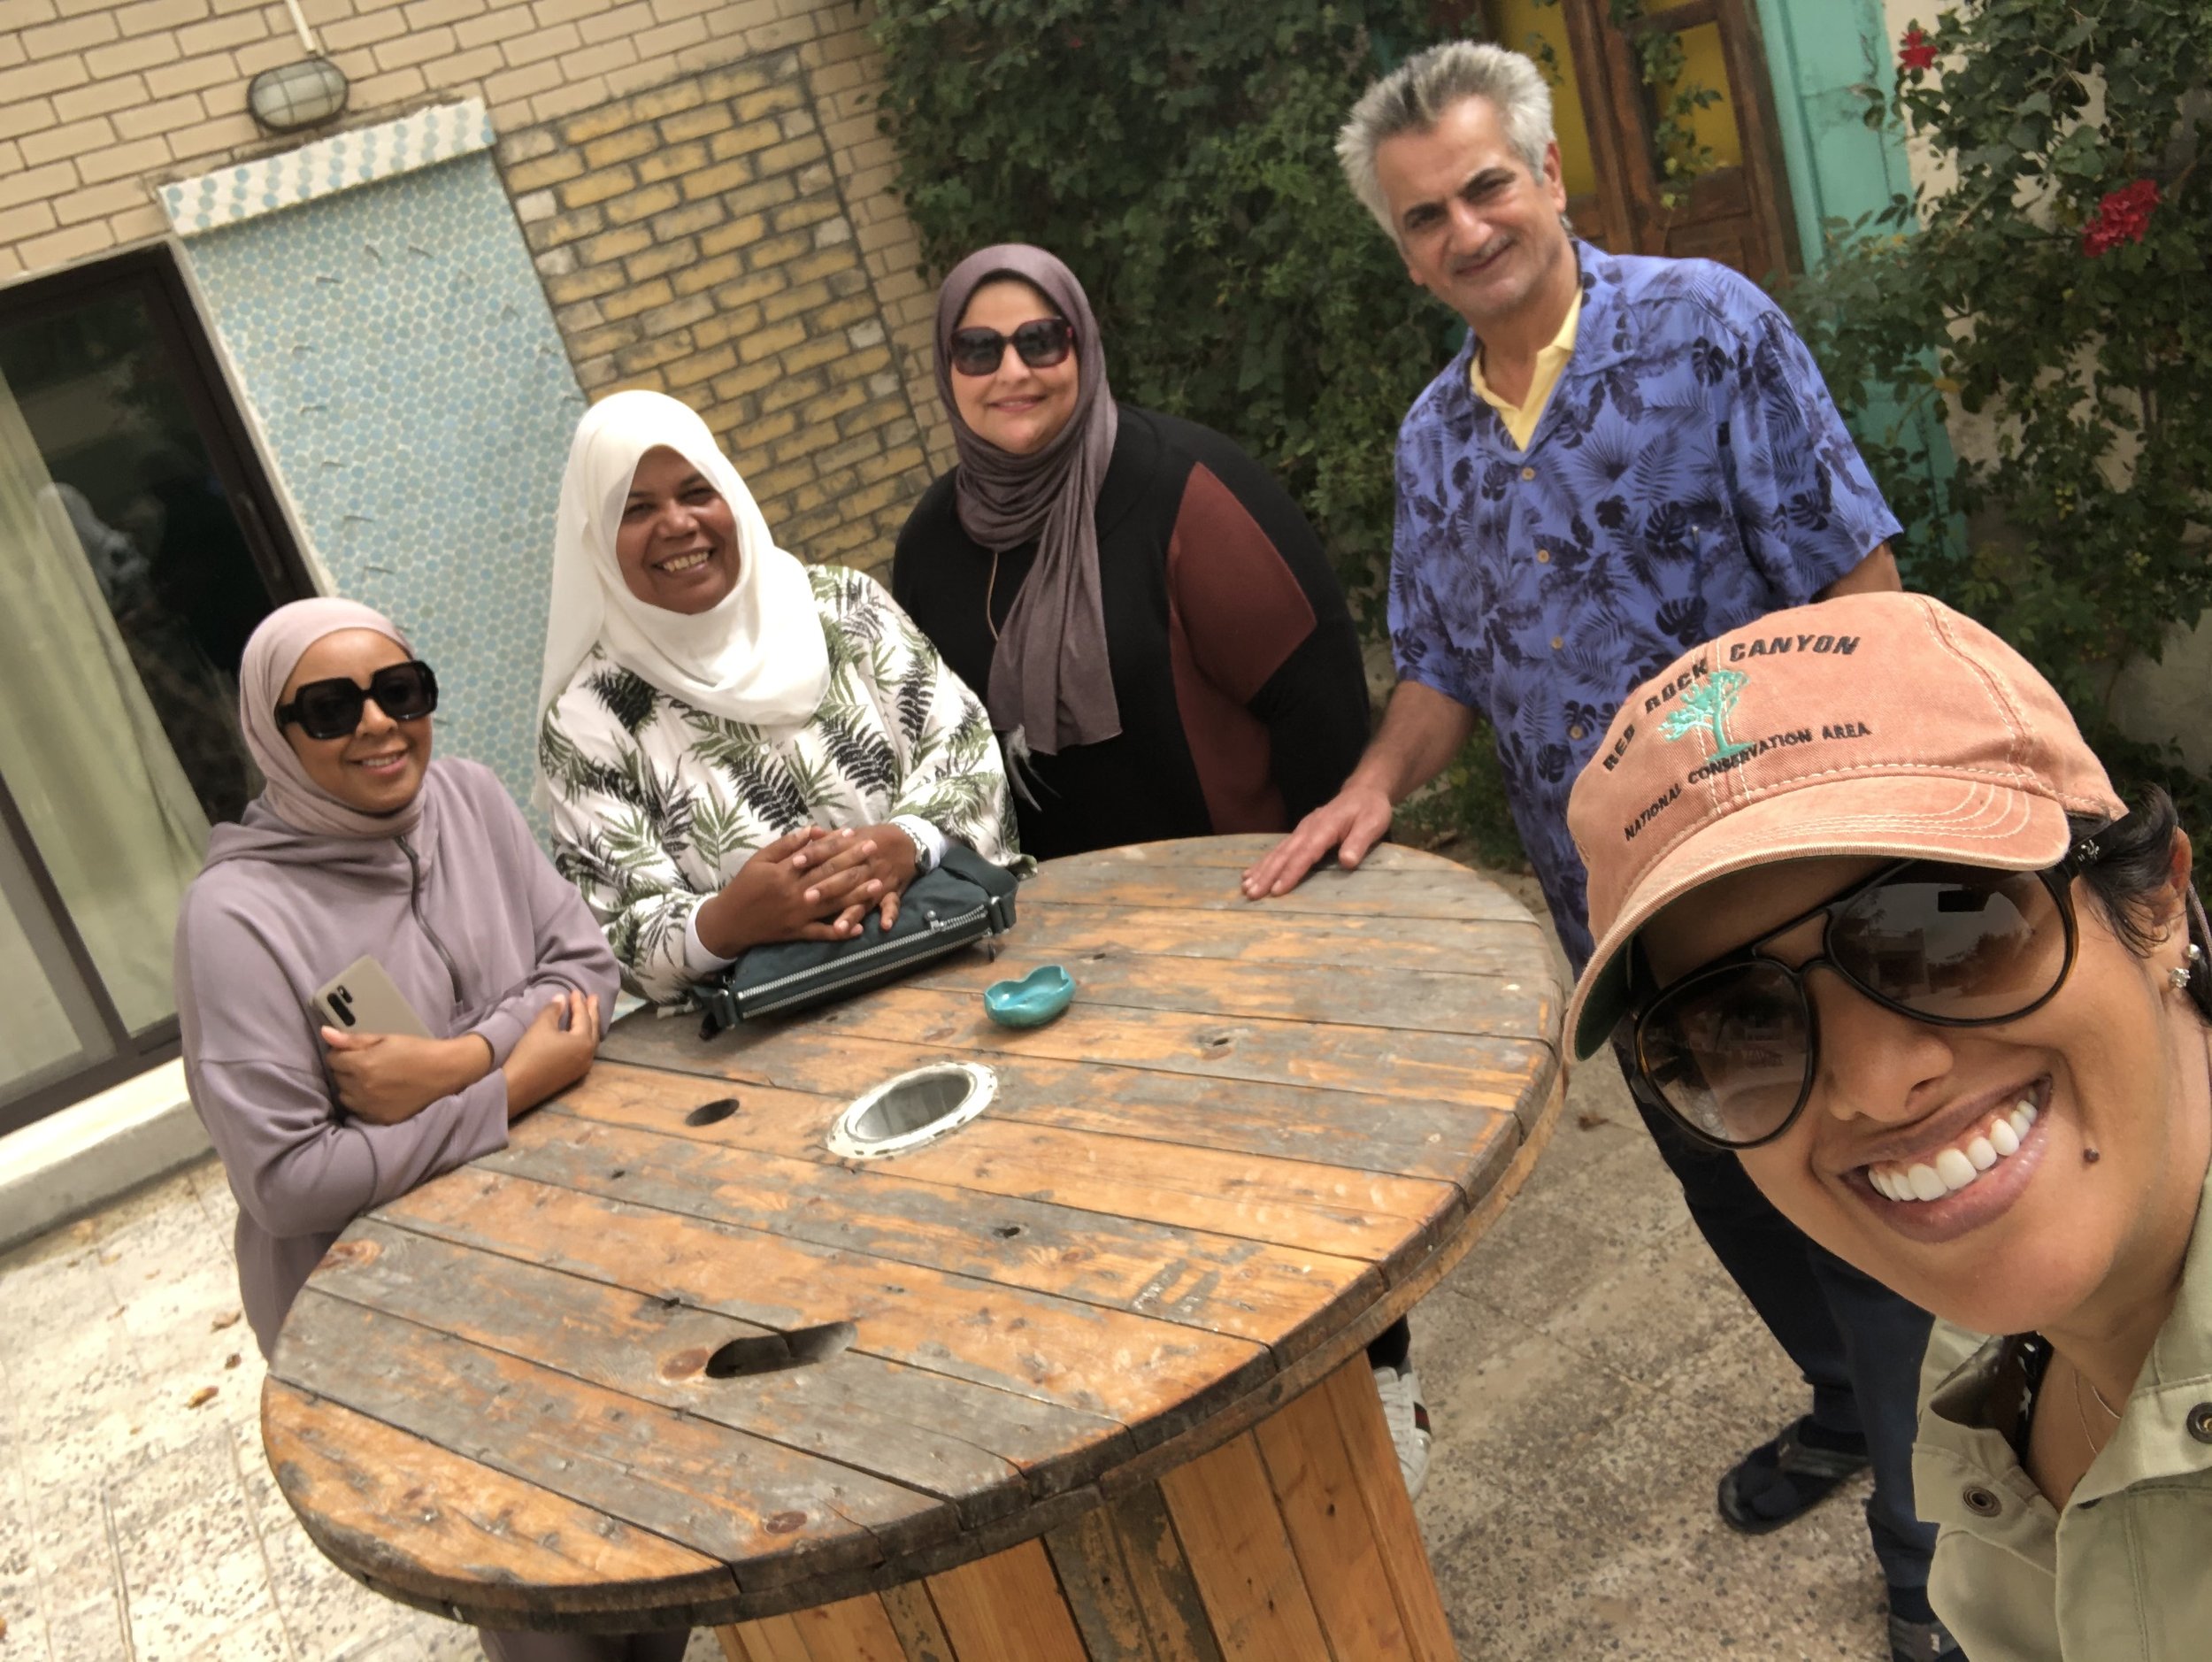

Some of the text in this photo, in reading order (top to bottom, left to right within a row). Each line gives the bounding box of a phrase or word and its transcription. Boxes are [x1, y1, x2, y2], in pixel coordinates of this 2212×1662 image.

[1602, 634, 1862, 773] RED ROCK CANYON
[1624, 720, 1873, 842] NATIONAL CONSERVATION AREA
